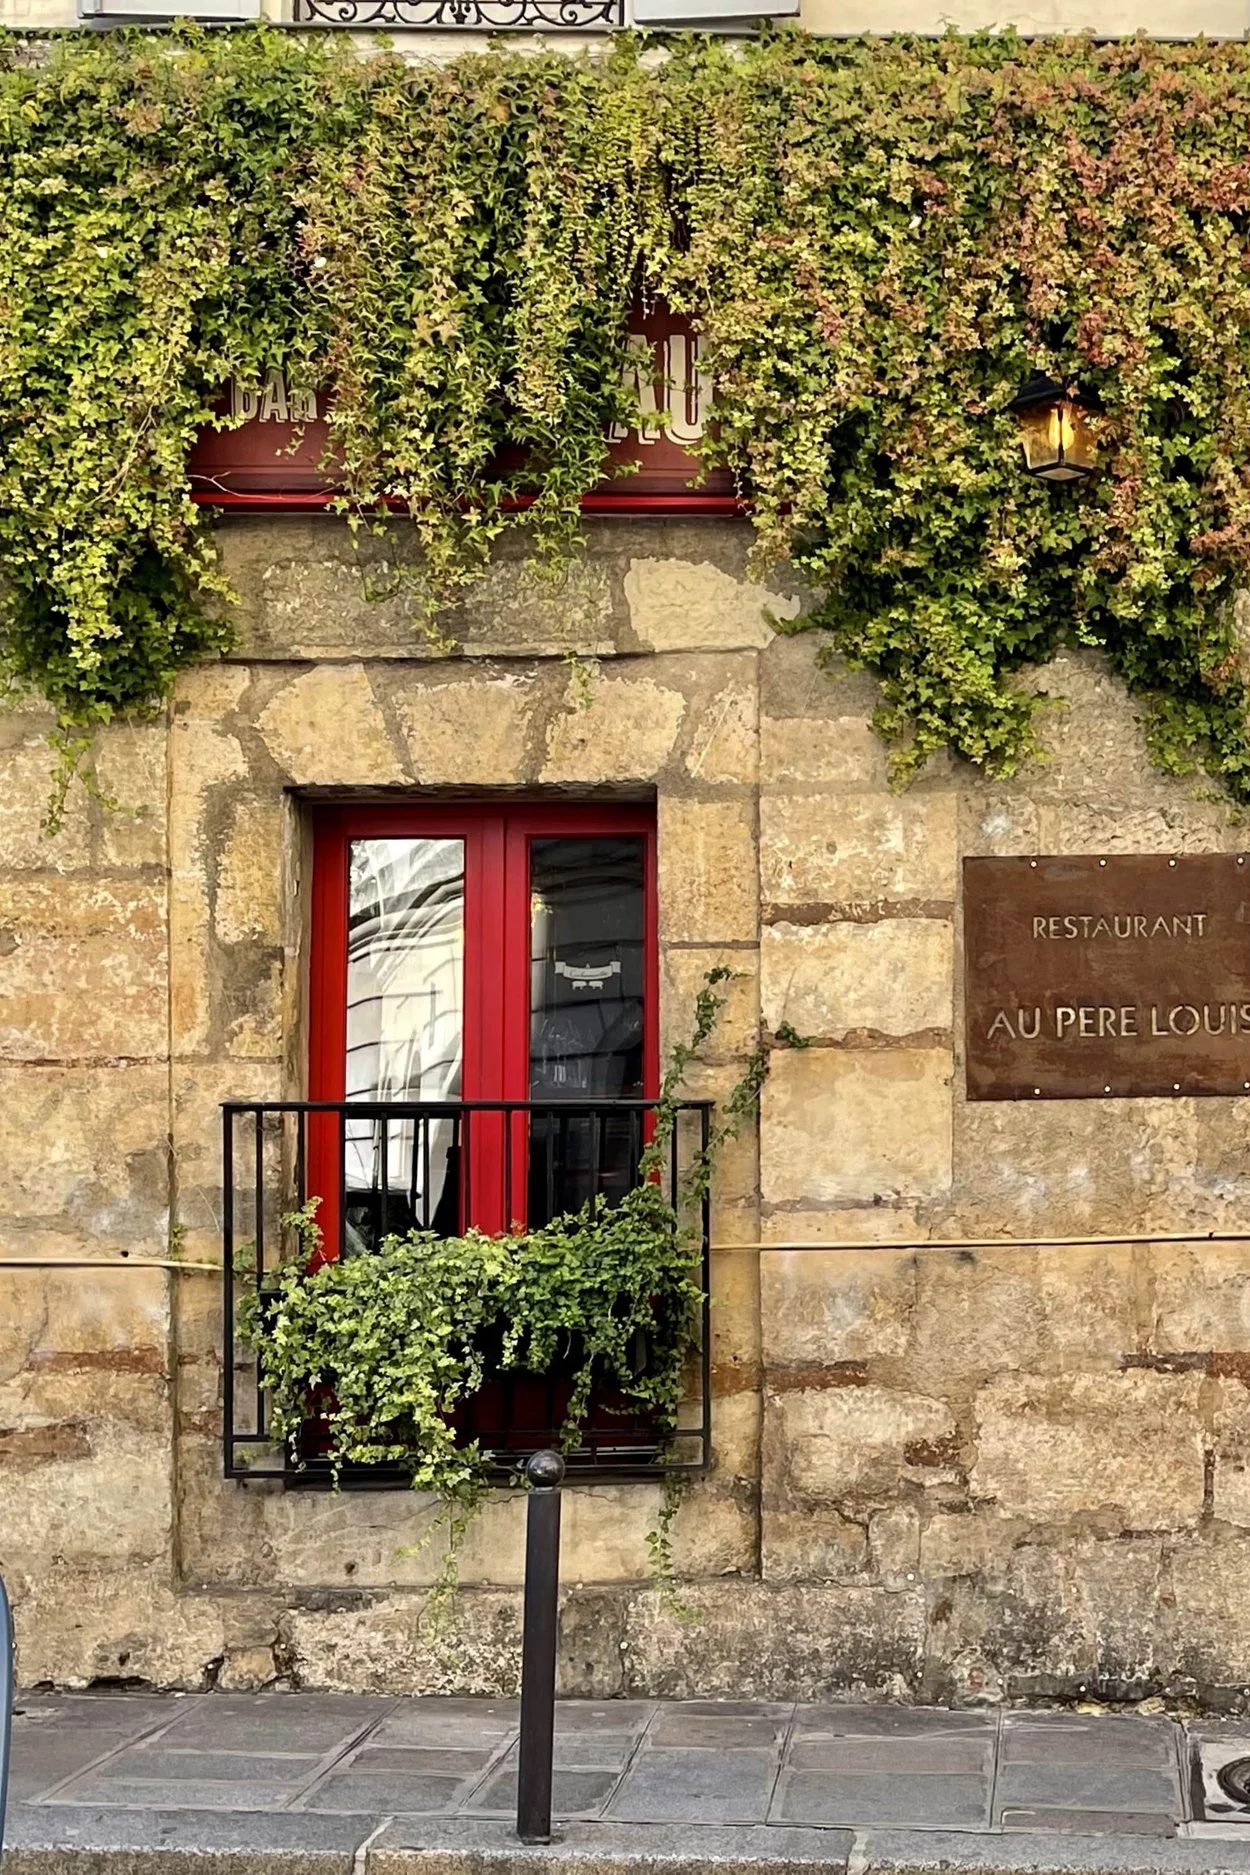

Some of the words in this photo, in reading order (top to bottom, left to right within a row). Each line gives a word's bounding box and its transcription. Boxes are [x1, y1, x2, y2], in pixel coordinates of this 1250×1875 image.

[1032, 914, 1208, 939] RESTAURANT
[986, 1006, 1041, 1039] AU
[1056, 1006, 1139, 1038] PERE
